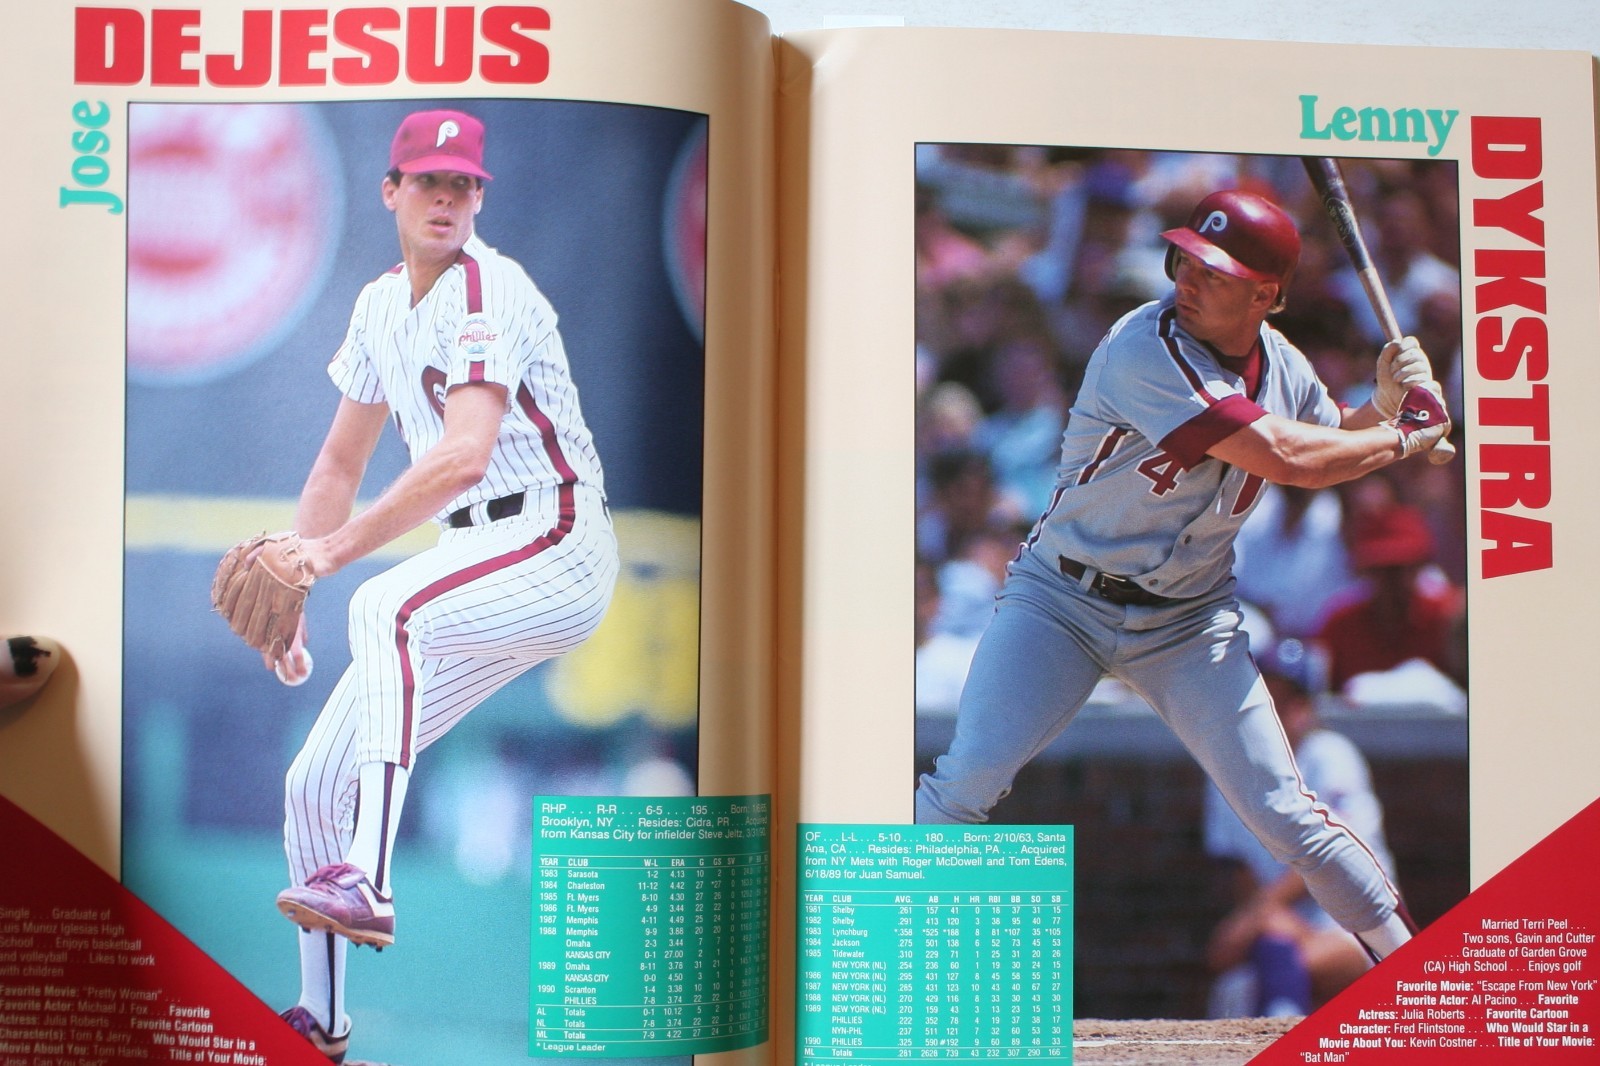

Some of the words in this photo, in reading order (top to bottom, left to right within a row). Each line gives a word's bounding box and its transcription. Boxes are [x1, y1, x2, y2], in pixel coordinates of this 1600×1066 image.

[74, 6, 549, 88] DEJESUS
[1299, 95, 1458, 156] Lenny
[60, 100, 125, 215] Jose
[1471, 115, 1553, 579] DYKSTRA
[1136, 453, 1181, 497] 4
[542, 803, 566, 813] RHP
[597, 804, 616, 814] R-R
[646, 805, 662, 815] 6-5
[691, 805, 707, 814] 195
[731, 803, 750, 814] Born:
[542, 816, 592, 830] Brooklyn,
[597, 817, 613, 826] NY
[638, 818, 681, 827] Resides:
[686, 817, 713, 827] Cidra,
[717, 817, 729, 826] PR
[541, 829, 566, 838] from
[570, 828, 609, 839] Kansas
[613, 829, 635, 841] City
[637, 830, 651, 839] for
[655, 830, 695, 839] infielder
[698, 829, 722, 839] Steve
[806, 832, 821, 841] OF
[842, 832, 857, 842] L-L
[879, 833, 901, 842] 5-10
[926, 833, 943, 842] 180
[964, 833, 990, 842] Born:
[994, 833, 1034, 843] 2/10/63,
[1037, 833, 1066, 842] Santa
[805, 844, 827, 854] Ana,
[831, 844, 846, 853] CA
[868, 844, 911, 854] Resides:
[916, 845, 981, 856] Philadelphia,
[986, 845, 999, 853] PA
[1021, 845, 1065, 856] Acquired
[541, 858, 558, 867] YEAR
[806, 856, 827, 865] from
[831, 857, 846, 865] NY
[851, 857, 874, 866] Mets
[878, 857, 897, 866] with
[903, 857, 931, 868] Roger
[936, 857, 982, 866] McDowell
[987, 857, 1004, 866] and
[1009, 857, 1030, 865] Tom
[1035, 856, 1066, 866] Edens,
[568, 870, 598, 878] Sarasota
[806, 870, 841, 878] 6/18/89
[844, 870, 856, 879] for
[859, 870, 882, 879] Juan
[886, 870, 924, 879] Samuel.
[638, 882, 658, 890] 11-12
[52, 908, 97, 920] Graduate
[101, 909, 110, 920] of
[1482, 919, 1519, 929] Married
[1522, 919, 1544, 929] Terri
[1548, 919, 1567, 929] Peel
[833, 928, 868, 937] Lynchburg
[1463, 933, 1483, 943] Two
[1486, 935, 1512, 944] sons,
[1516, 933, 1542, 943] Gavin
[1545, 933, 1562, 943] and
[1566, 933, 1595, 943] Cutter
[898, 939, 912, 947] .275
[566, 951, 593, 959] KANSAS
[595, 951, 610, 959] CITY
[833, 950, 864, 958] Tidewater
[1462, 947, 1505, 957] Graduate
[1509, 947, 1518, 957] of
[1521, 947, 1555, 957] Garden
[1559, 947, 1586, 957] Grove
[132, 955, 154, 965] work
[1424, 961, 1445, 974] (CA)
[1449, 961, 1470, 973] High
[1474, 961, 1507, 971] School
[1529, 961, 1560, 973] Enjoys
[1563, 961, 1581, 973] golf
[1397, 981, 1437, 991] Favorite
[1441, 981, 1473, 991] Movie:
[1519, 980, 1543, 991] From
[1547, 980, 1568, 990] New
[565, 997, 596, 1005] PHILLIES
[1396, 995, 1436, 1005] Favorite
[1440, 995, 1468, 1005] Actor:
[1472, 995, 1481, 1004] Al
[1485, 995, 1516, 1005] Pacino
[1539, 994, 1578, 1004] Favorite
[170, 1006, 210, 1018] Favorite
[1359, 1009, 1398, 1020] Actress:
[1401, 1009, 1424, 1019] Julia
[1428, 1009, 1465, 1019] Roberts
[1487, 1008, 1527, 1019] Favorite
[1530, 1008, 1568, 1018] Cartoon
[132, 1018, 171, 1030] Favorite
[175, 1020, 213, 1033] Cartoon
[1340, 1024, 1390, 1034] Character:
[1394, 1023, 1415, 1033] Fred
[1419, 1023, 1465, 1033] Flintstone
[1486, 1023, 1508, 1032] Who
[1512, 1022, 1543, 1032] Would
[1547, 1022, 1567, 1032] Star
[1570, 1022, 1579, 1032] in
[1583, 1024, 1588, 1032] a
[153, 1034, 175, 1045] Who
[179, 1035, 210, 1047] Would
[213, 1037, 233, 1048] Star
[237, 1039, 246, 1049] in
[249, 1042, 255, 1050] a
[543, 1043, 574, 1052] League
[832, 1038, 862, 1046] PHILLIES
[1320, 1038, 1350, 1048] Movie
[1353, 1038, 1381, 1048] About
[1385, 1037, 1406, 1047] You:
[1410, 1037, 1436, 1047] Kevin
[1440, 1037, 1477, 1047] Costner
[1498, 1036, 1520, 1046] Title
[1524, 1036, 1533, 1046] of
[1536, 1036, 1559, 1046] Your
[1562, 1036, 1594, 1046] Movie:
[170, 1049, 192, 1061] Title
[195, 1051, 204, 1061] of
[208, 1051, 230, 1063] Your
[234, 1053, 267, 1066] Movie:
